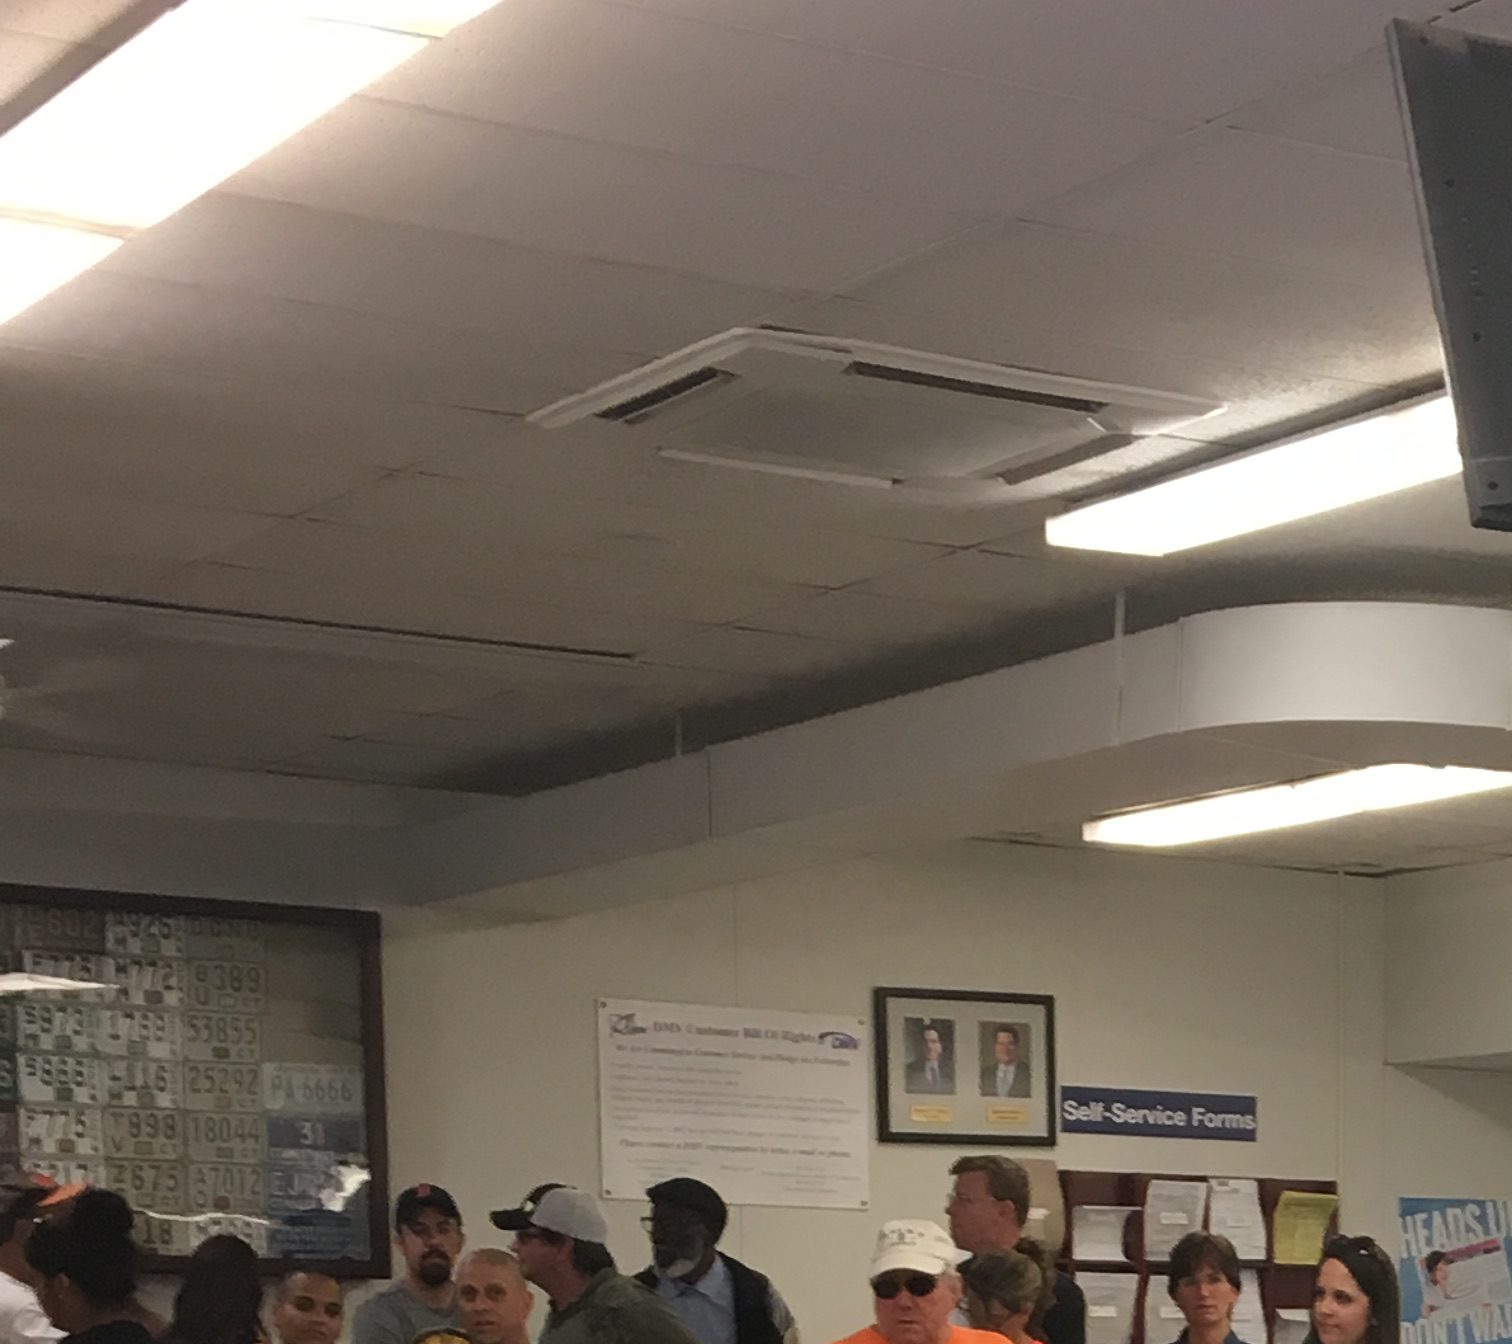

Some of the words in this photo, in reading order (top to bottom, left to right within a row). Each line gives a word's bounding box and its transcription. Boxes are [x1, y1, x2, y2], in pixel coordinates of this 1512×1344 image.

[189, 1065, 258, 1096] 25292
[1063, 1099, 1188, 1127] Self-Service
[1191, 1106, 1256, 1131] Forms
[1399, 1203, 1485, 1259] HEADS
